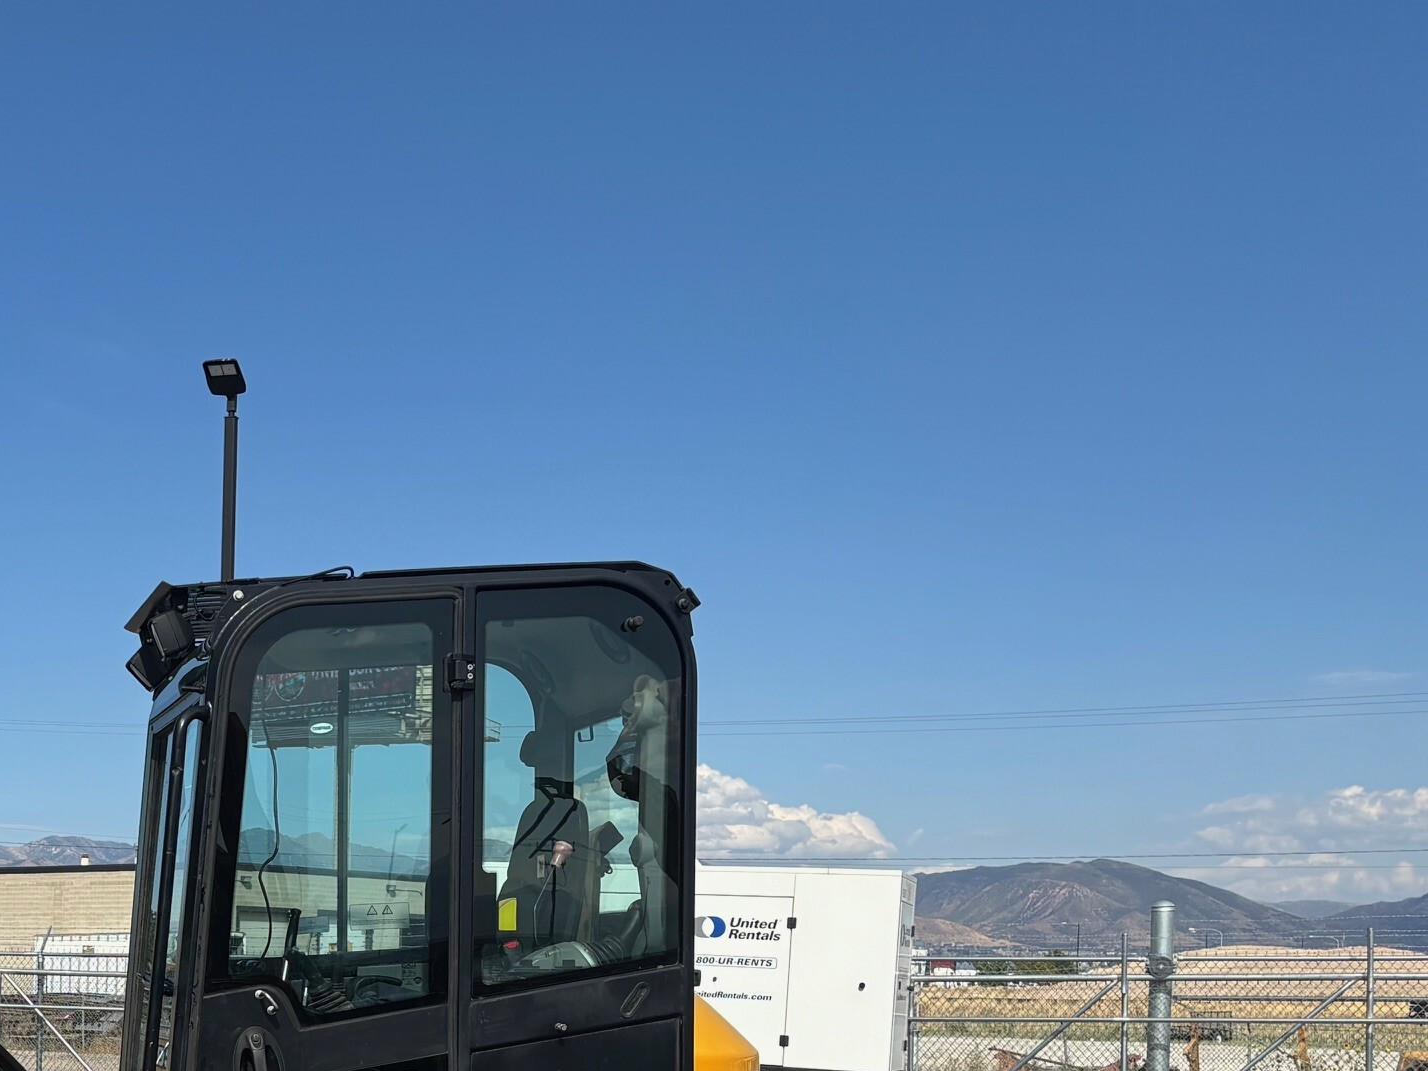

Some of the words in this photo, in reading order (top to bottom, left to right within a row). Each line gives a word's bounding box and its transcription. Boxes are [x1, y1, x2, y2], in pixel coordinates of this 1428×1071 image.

[730, 917, 778, 929] United
[728, 929, 781, 941] Rentals
[696, 991, 772, 1001] itedRentals.com
